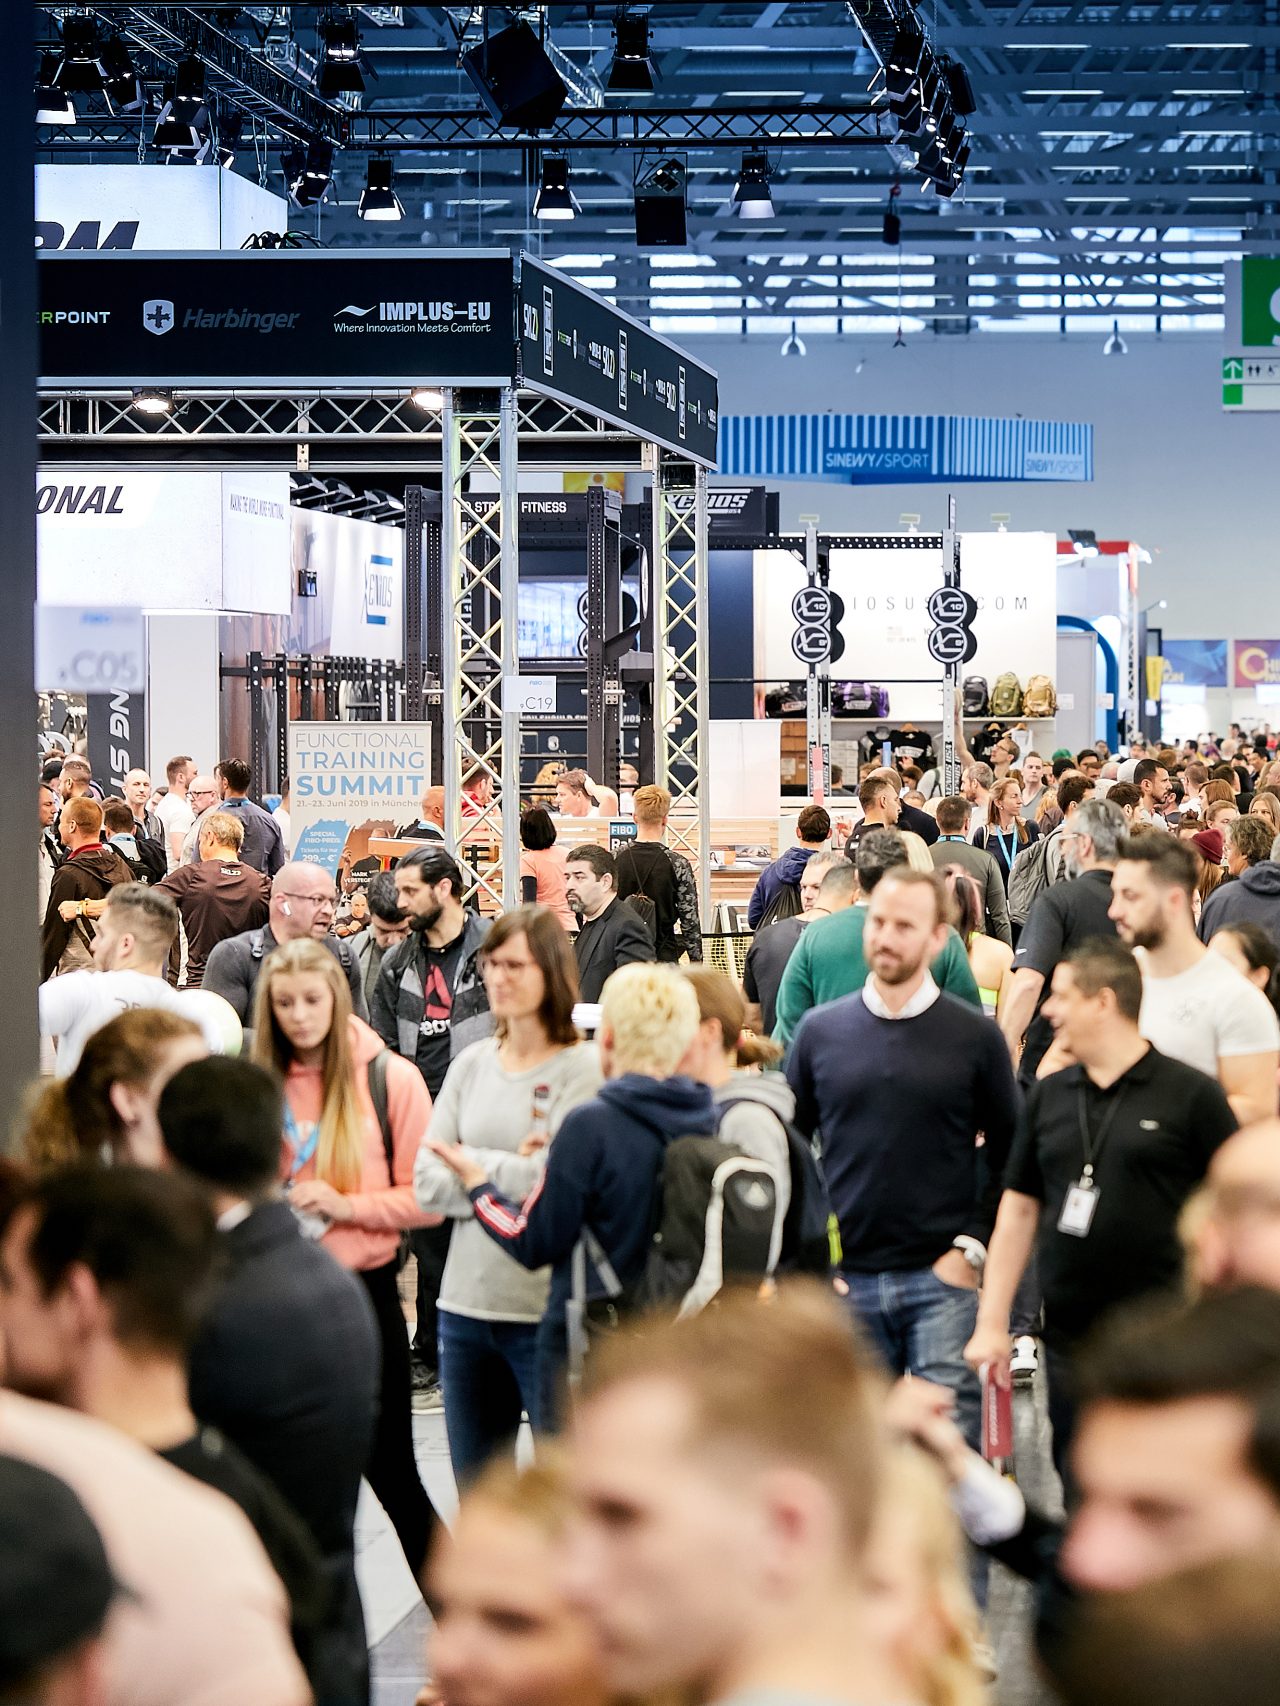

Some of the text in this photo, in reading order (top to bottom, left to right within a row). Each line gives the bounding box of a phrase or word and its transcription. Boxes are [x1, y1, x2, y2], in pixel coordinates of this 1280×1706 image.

[182, 308, 301, 334] Harbinger
[334, 322, 491, 333] Where Innovation Meets Comfort
[826, 452, 928, 469] SINEWY/SPORT
[521, 501, 567, 513] FITNESS
[666, 494, 748, 509] XEIOS
[525, 696, 554, 711] C19
[295, 733, 425, 748] FUNCTIONAL
[296, 752, 425, 769] TRAINING
[296, 775, 425, 797] SUMMIT
[326, 800, 347, 808] Juni
[611, 825, 633, 835] FIBO
